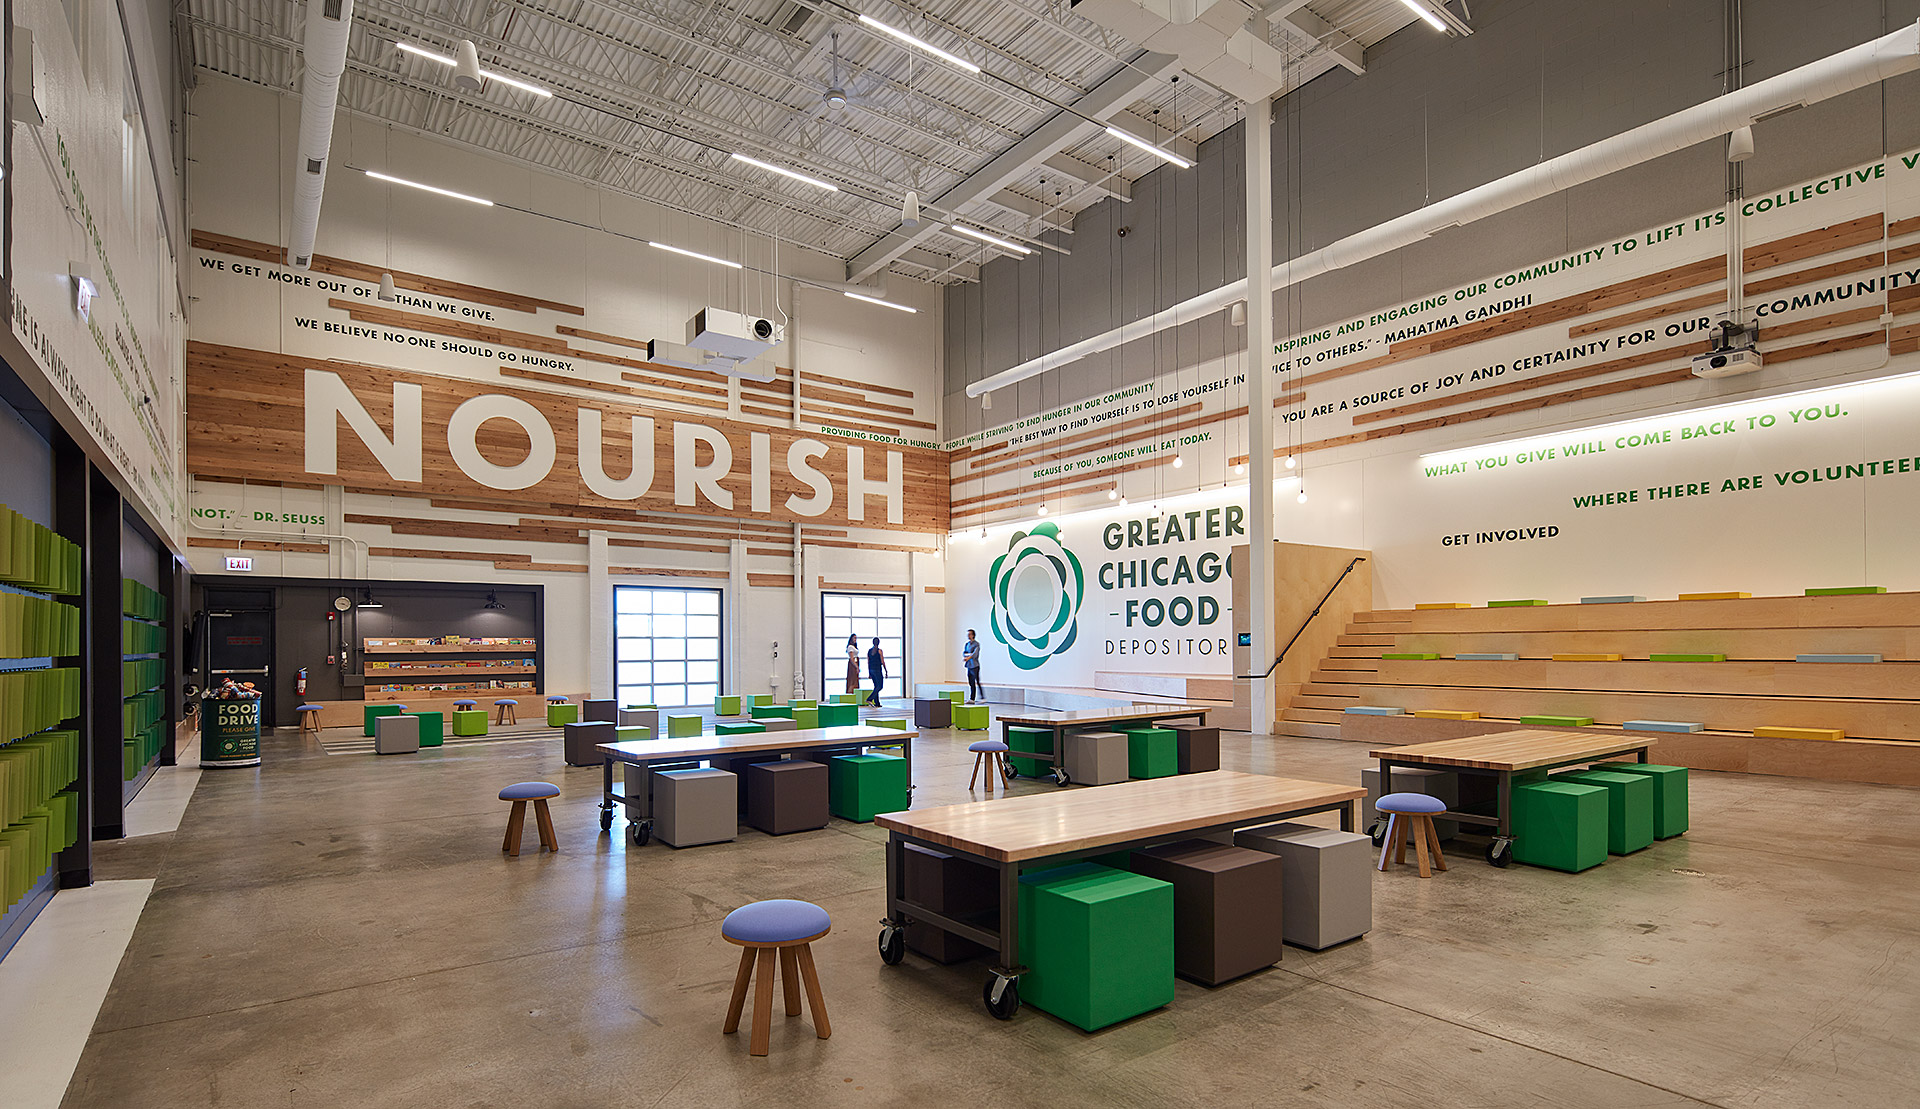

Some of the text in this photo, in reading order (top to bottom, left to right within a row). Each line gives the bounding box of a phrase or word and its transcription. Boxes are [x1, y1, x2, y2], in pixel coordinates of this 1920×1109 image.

[56, 127, 70, 179] YOU
[72, 170, 84, 218] GIVE
[199, 257, 224, 270] WE
[232, 264, 261, 277] GET
[268, 270, 311, 287] MORE
[317, 280, 347, 294] OUT
[353, 287, 371, 298] OF
[395, 294, 432, 310] THAN
[437, 302, 456, 314] WE
[462, 307, 495, 322] GIVE.
[945, 438, 965, 450] PEOPLE
[967, 432, 984, 444] WHILE
[985, 424, 1014, 440] STRIVING
[1016, 421, 1024, 430] TO
[1026, 417, 1040, 427] END
[1042, 407, 1071, 422] HUNGER
[1073, 404, 1082, 412] IN
[1084, 398, 1101, 409] OUR
[1103, 382, 1155, 404] COMMUNITY
[1274, 330, 1331, 354] NSPIRING
[1336, 320, 1365, 336] AND
[1370, 295, 1448, 326] ENGAGING
[1454, 283, 1487, 301] OUR
[1494, 247, 1604, 289] COMMUNITY
[1612, 239, 1637, 255] TO
[1646, 223, 1685, 246] LIFT
[1695, 212, 1726, 232] ITS
[1742, 163, 1884, 216] COLLECTIVE
[295, 317, 575, 372] WE BELIEVE NO ONE SHOULD GO HUNGRY.
[1281, 269, 1920, 424] YOU ARE A SOURCE OF JOY AND CERTAINTY FOR OUR COMMUNITY
[31, 316, 38, 350] IS
[41, 333, 68, 392] ALWAYS
[70, 374, 86, 416] RIGHT
[88, 400, 94, 426] TO
[1025, 432, 1039, 442] BEST
[1041, 427, 1057, 437] WAY
[1058, 424, 1068, 432] TO
[1070, 418, 1088, 429] FIND
[1090, 407, 1130, 425] YOURSELF
[1132, 404, 1140, 412] IS
[1142, 400, 1154, 408] TO
[1157, 392, 1178, 405] LOSE
[1182, 378, 1229, 398] YOURSELF
[1234, 374, 1245, 385] IN
[1296, 356, 1311, 368] TO
[1384, 315, 1459, 344] MAHATMA
[1465, 294, 1532, 321] GANDHI
[304, 368, 904, 525] NOURISH
[821, 426, 941, 450] PROVIDING FOOD FOR HUNGRY
[1033, 432, 1212, 478] BECAUSE OF YOU, SOMEONE WILL EAT TODAY.
[1425, 404, 1848, 477] WHAT YOU GIVE WILL COME BACK TO YOU.
[1573, 490, 1638, 508] WHERE
[1647, 482, 1710, 500] THERE
[1721, 476, 1762, 492] ARE
[254, 512, 278, 522] DR.
[283, 513, 325, 525] SEUSS
[1103, 505, 1244, 550] GREATER
[1442, 526, 1559, 546] GET INVOLVED
[230, 559, 250, 569] EXIT
[1126, 596, 1220, 628] FOOD
[1105, 639, 1227, 655] DEPOSITOR
[218, 715, 258, 725] DRIVE
[219, 704, 258, 714] FOOD
